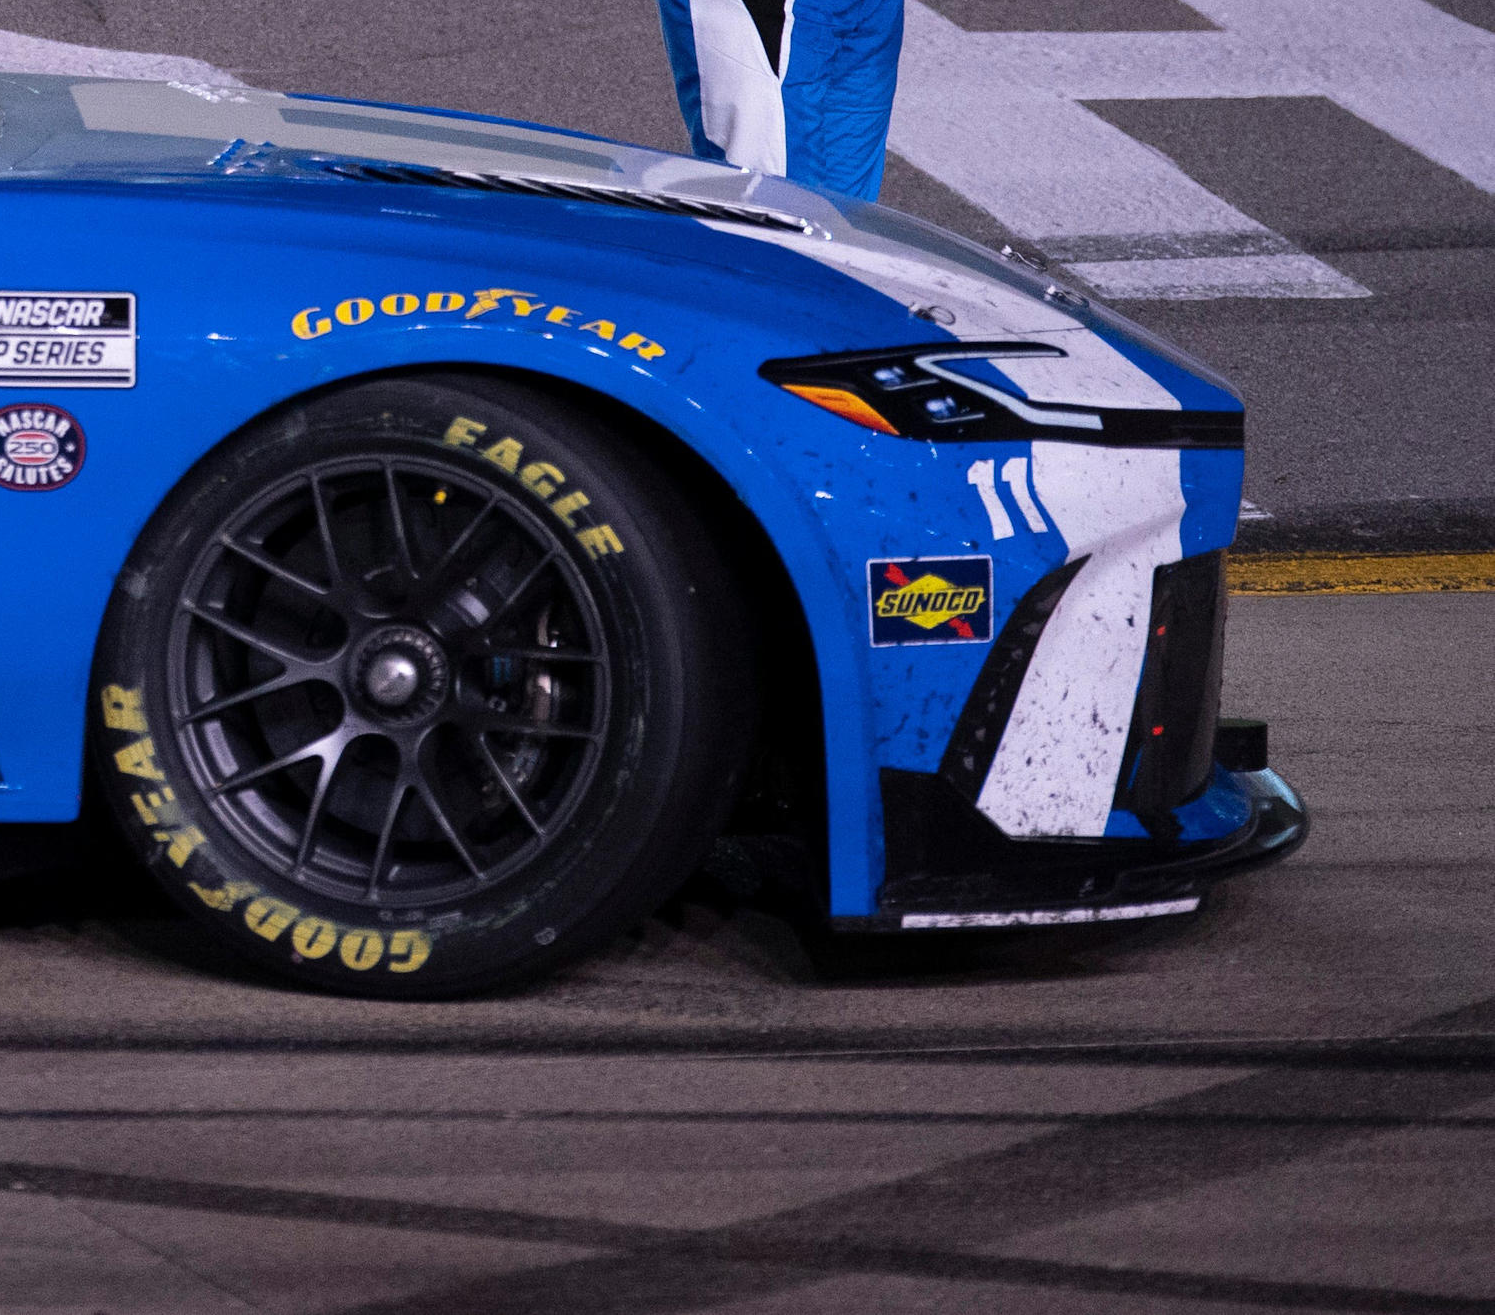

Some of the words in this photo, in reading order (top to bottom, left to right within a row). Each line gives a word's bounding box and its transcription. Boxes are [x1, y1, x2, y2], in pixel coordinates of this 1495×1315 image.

[14, 341, 106, 365] SERIES
[290, 288, 669, 363] GOODYEAR
[8, 442, 57, 454] 250
[441, 414, 625, 562] EAGLE
[967, 458, 1047, 540] 11
[881, 590, 980, 614] SUNOCO
[100, 683, 434, 974] GOODYEAR
